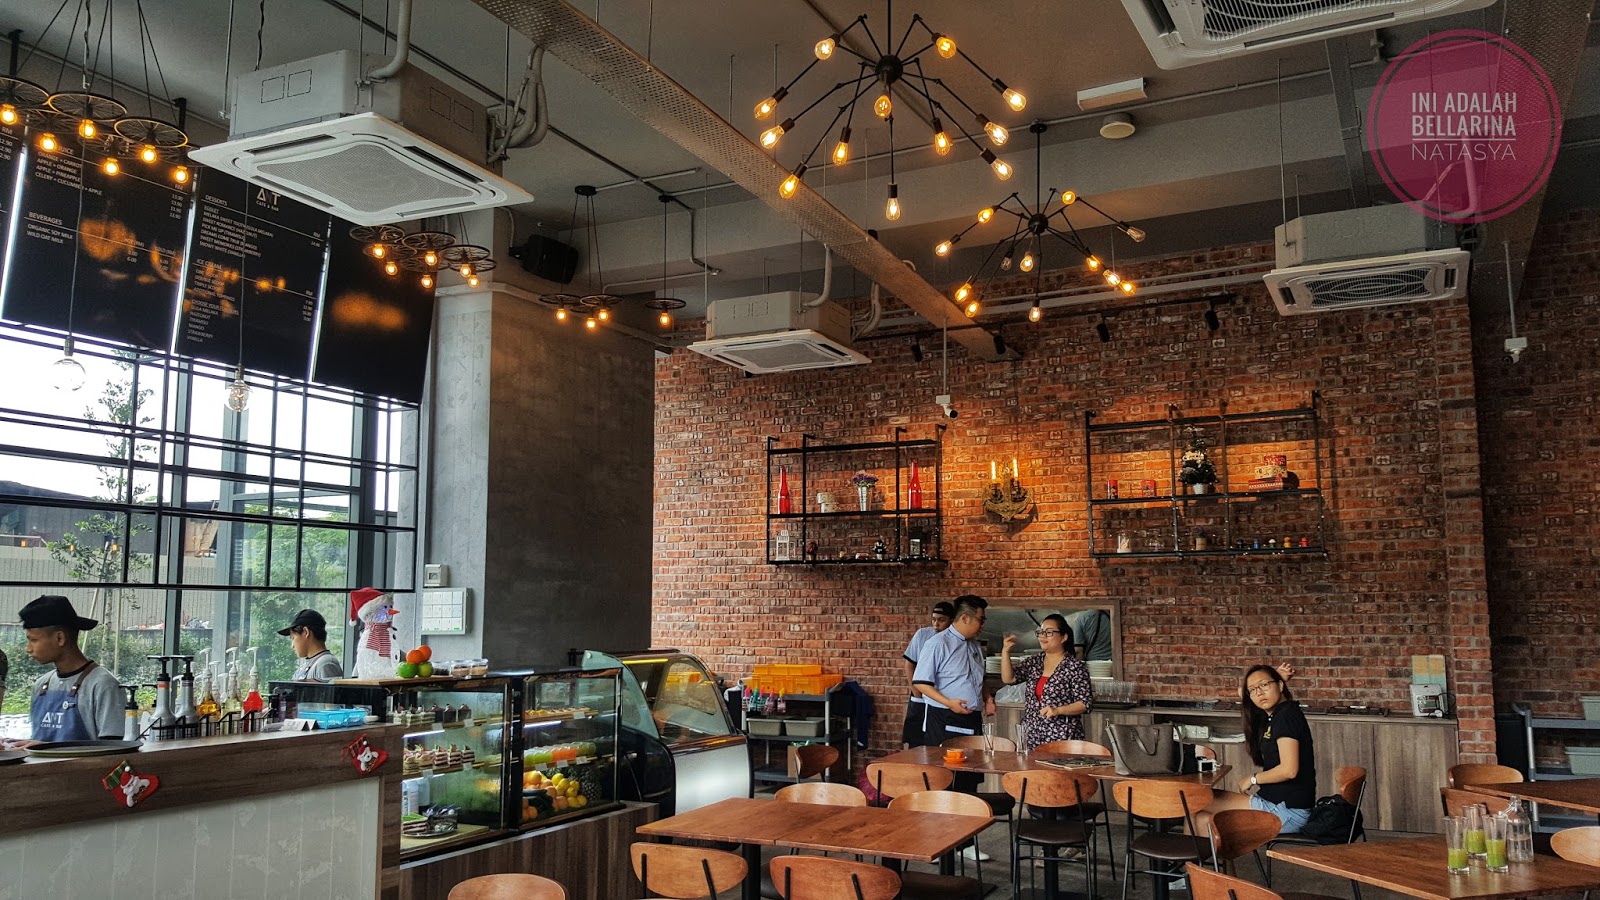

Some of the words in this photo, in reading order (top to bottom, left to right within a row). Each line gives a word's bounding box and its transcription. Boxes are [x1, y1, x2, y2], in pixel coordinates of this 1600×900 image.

[38, 152, 58, 162] ORANGE
[64, 160, 82, 168] CARROT
[36, 158, 52, 166] APPLE
[56, 164, 78, 174] ORANGE
[36, 166, 51, 174] APPLE
[56, 171, 81, 182] PINEAPPLE
[35, 172, 53, 181] CELERY
[88, 187, 102, 196] APPLE
[205, 194, 228, 206] DESSERTS
[28, 212, 62, 225] BEVERAGES
[204, 212, 220, 220] MELAKA
[28, 224, 50, 234] ORGANIC
[201, 229, 218, 238] DREAMS
[200, 240, 214, 248] SNOWY
[214, 239, 234, 249] MEMORIES
[204, 260, 222, 269] CREAM
